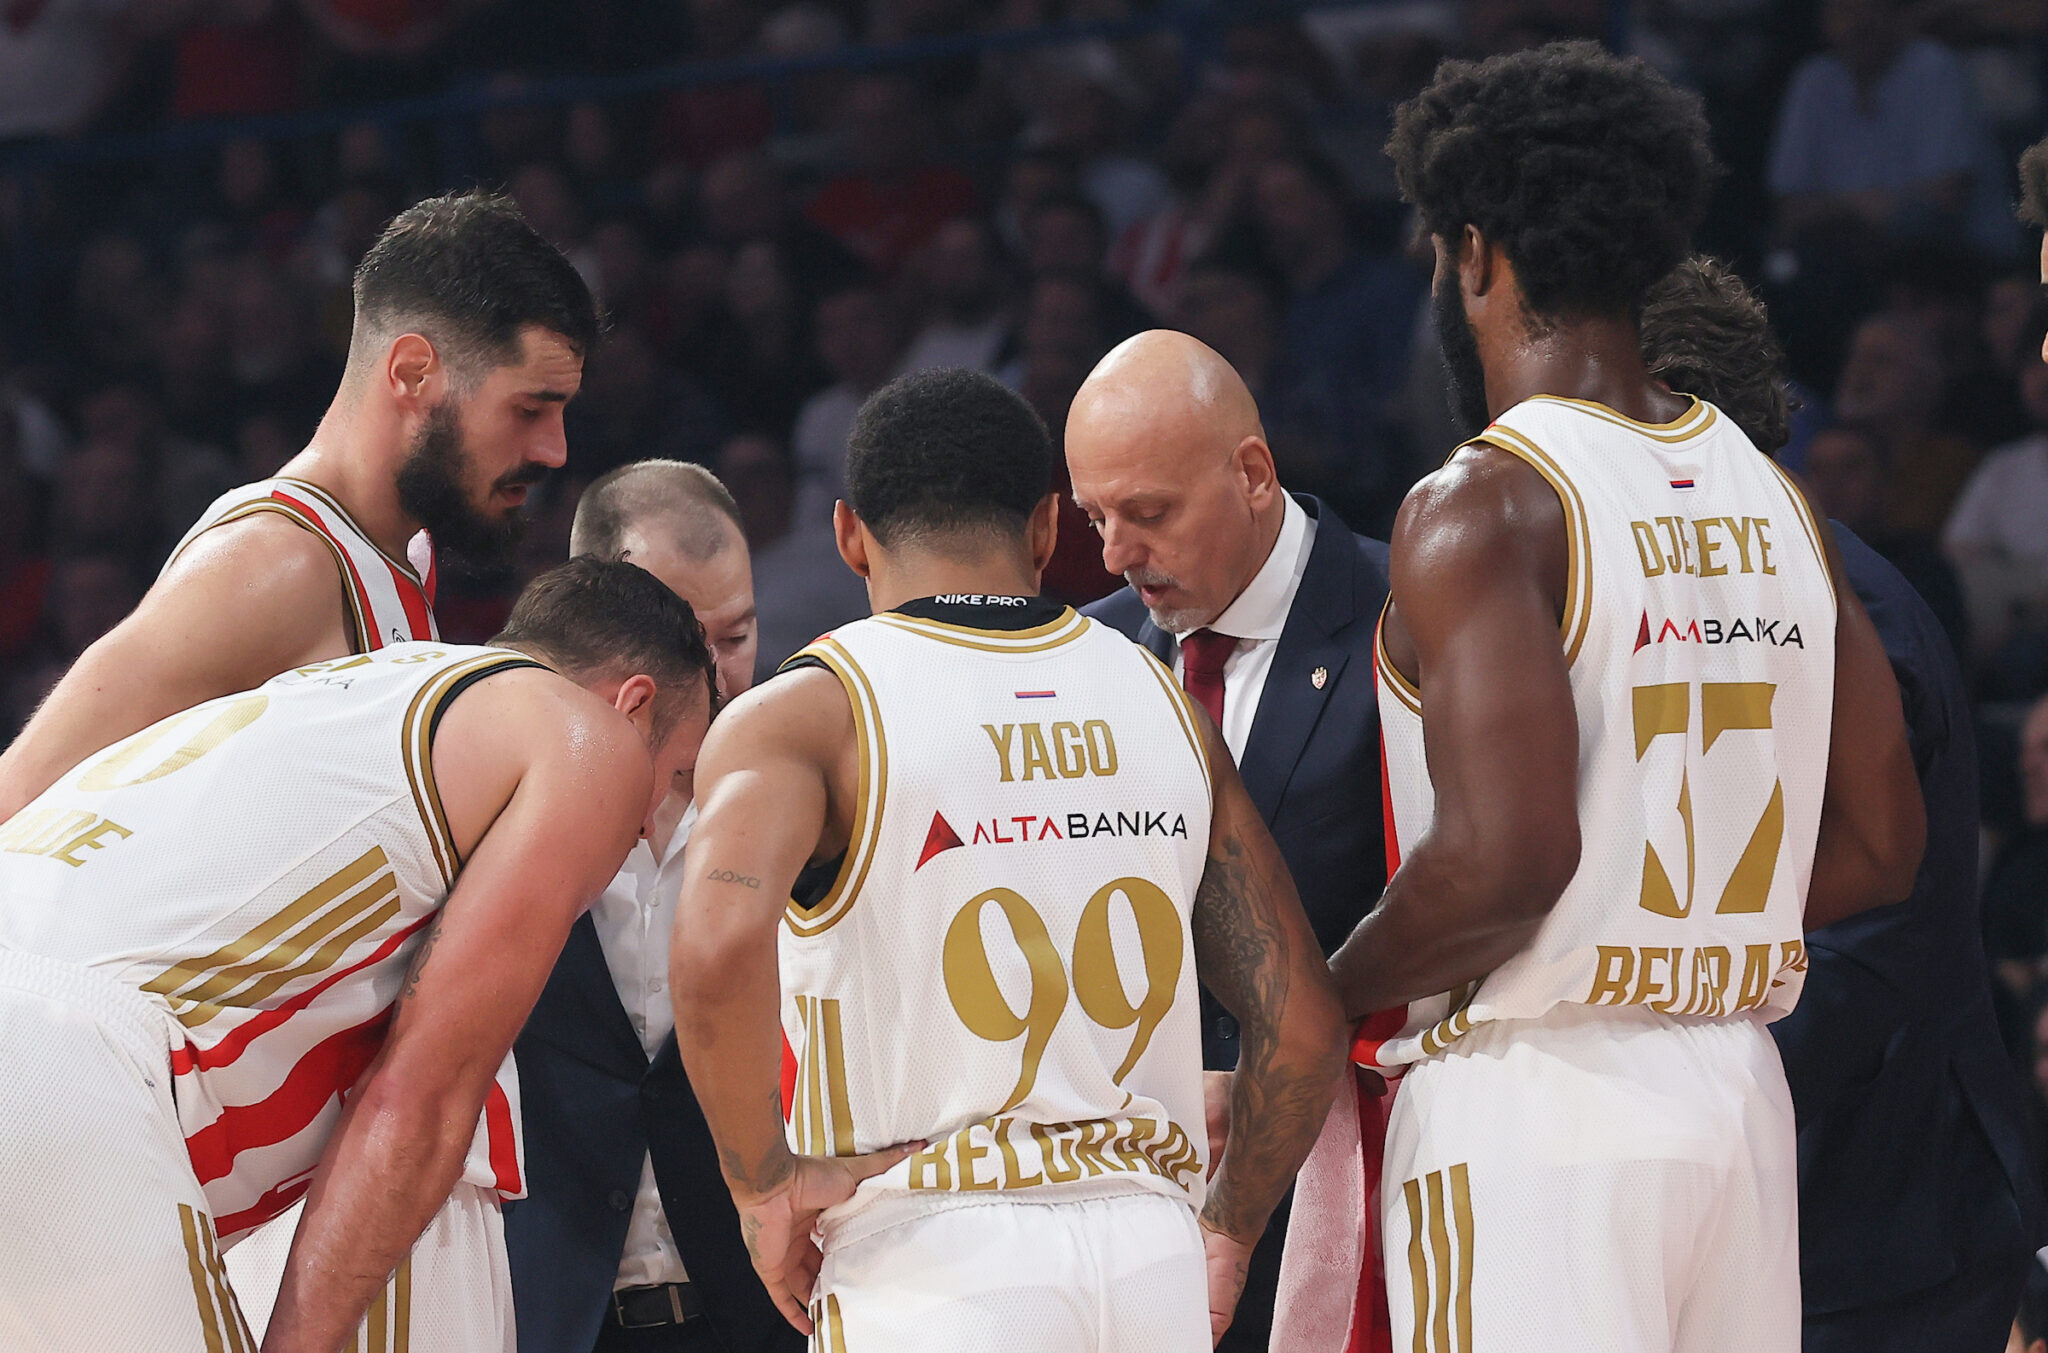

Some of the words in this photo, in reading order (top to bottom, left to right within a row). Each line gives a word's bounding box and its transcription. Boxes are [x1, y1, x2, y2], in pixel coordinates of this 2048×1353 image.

[934, 594, 984, 606] NIKE
[985, 595, 1028, 607] PRO
[981, 719, 1118, 782] YAGO
[972, 811, 1188, 845] ALTABANKA
[1632, 681, 1785, 919] 37
[943, 876, 1184, 1113] 99
